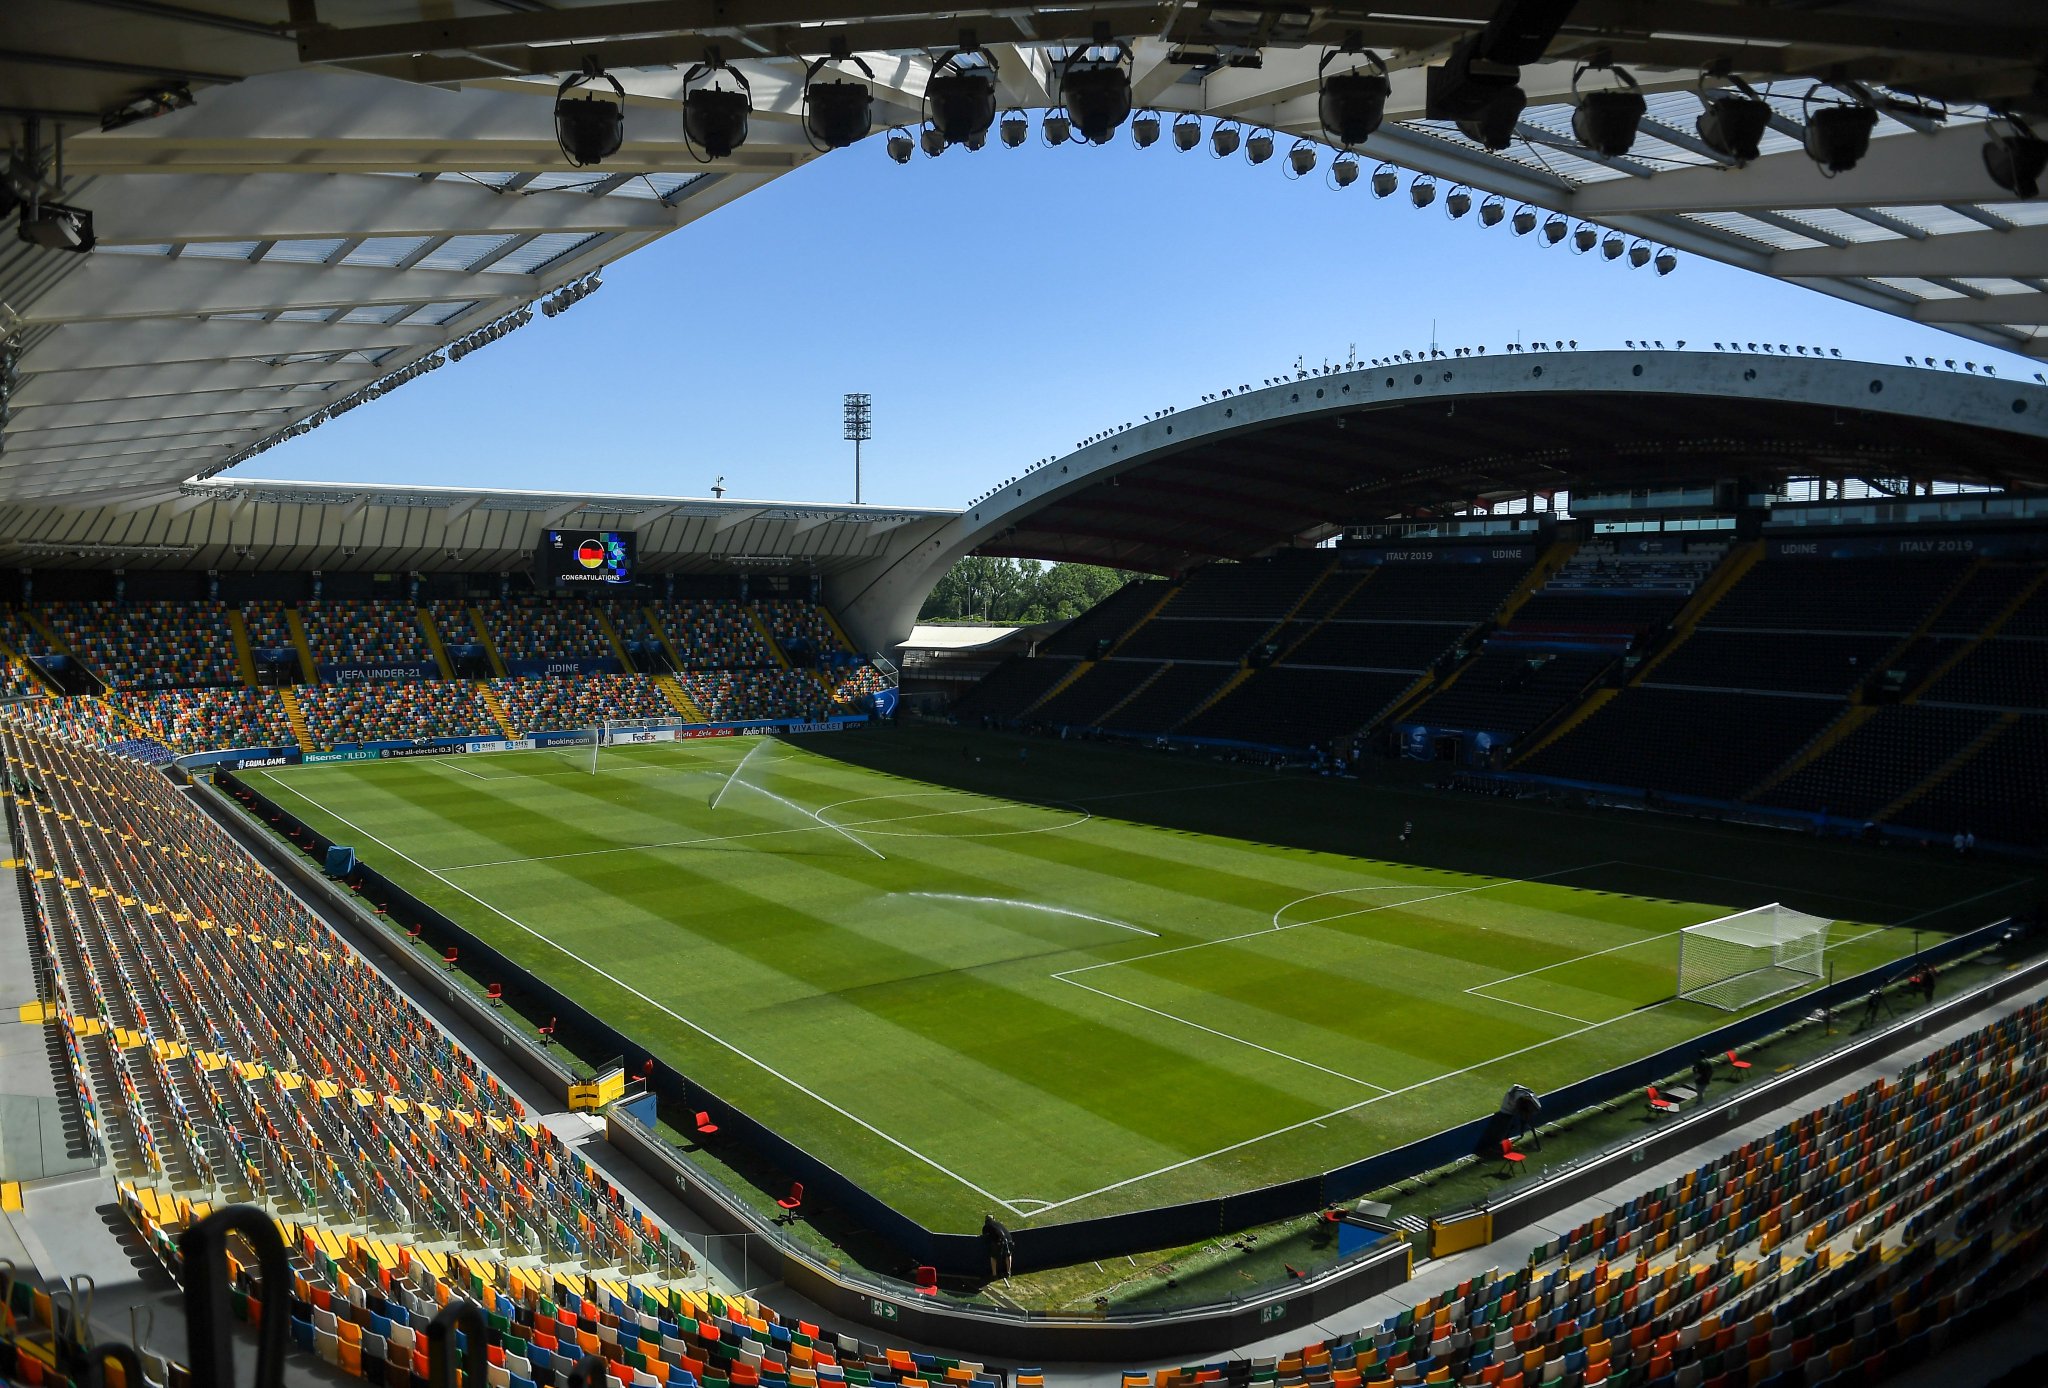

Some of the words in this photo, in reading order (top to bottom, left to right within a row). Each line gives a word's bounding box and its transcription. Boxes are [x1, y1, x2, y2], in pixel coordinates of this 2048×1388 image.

[1781, 544, 1817, 554] UDINE
[1900, 541, 1934, 552] ITALY
[1937, 540, 1974, 551] 2019
[1386, 552, 1408, 561] ITALY
[1410, 552, 1433, 560] 2019
[1492, 550, 1522, 559] UDINE
[548, 664, 579, 673] UDINE
[336, 670, 365, 679] UEFA
[367, 669, 421, 678] UNDER-21
[791, 722, 842, 733] VIVATICKET
[632, 732, 656, 741] FedEx
[547, 738, 590, 746] Booking.com
[404, 747, 438, 756] all-electric
[305, 754, 342, 762] Hisense
